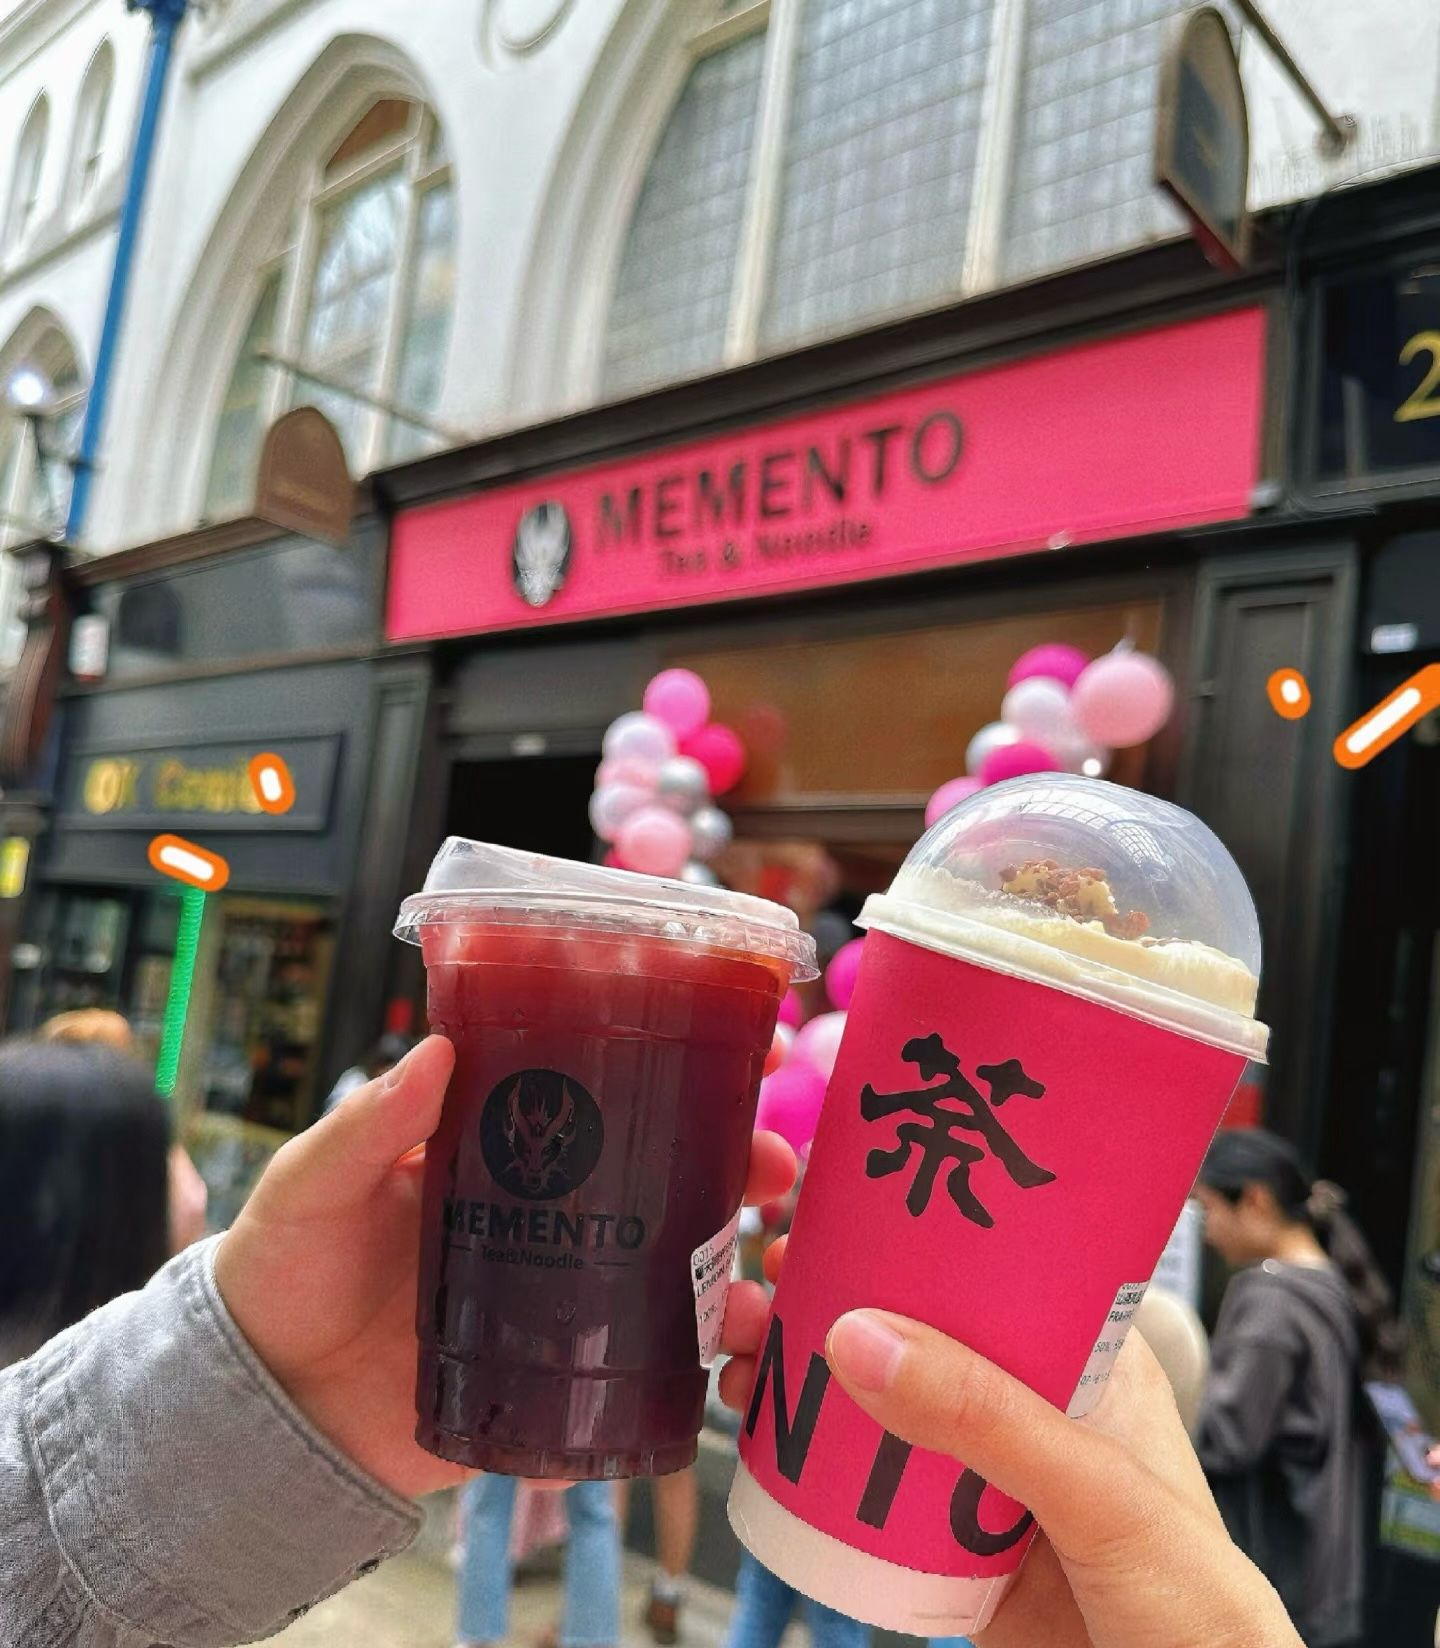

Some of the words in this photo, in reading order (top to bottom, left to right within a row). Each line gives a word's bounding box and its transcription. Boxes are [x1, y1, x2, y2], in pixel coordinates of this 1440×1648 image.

[595, 411, 964, 547] MEMENTO
[860, 1033, 1057, 1229] 茶
[443, 1199, 646, 1250] MEMENTO
[481, 1246, 584, 1270] Tea&Noodle
